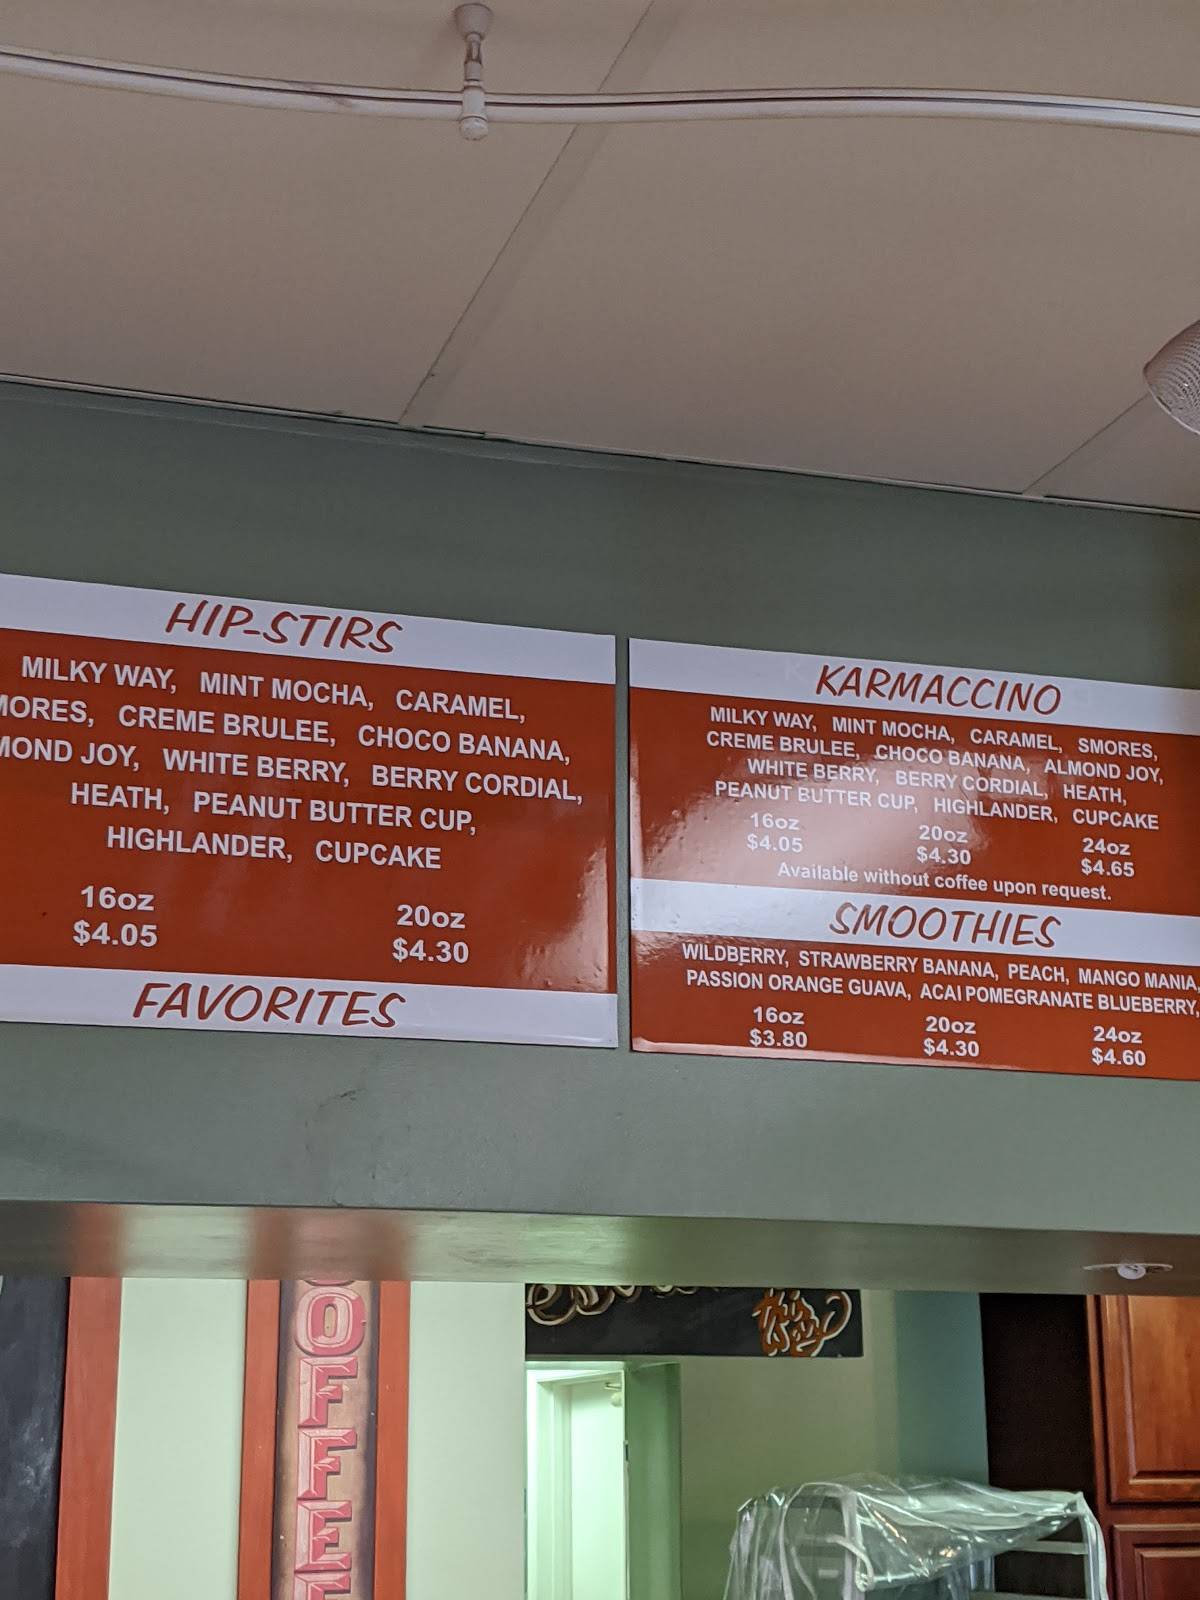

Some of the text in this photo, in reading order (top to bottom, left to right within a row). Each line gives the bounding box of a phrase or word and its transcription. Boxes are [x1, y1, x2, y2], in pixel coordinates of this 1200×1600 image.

[165, 600, 403, 653] HIP-STIRS
[22, 656, 524, 723] MILKY WAY, MINT MOCHA, CARAMEL,
[815, 664, 1061, 716] KARMACCINO
[119, 705, 214, 733] CREME
[224, 713, 335, 747] BRULEE,
[359, 725, 450, 752] CHOCO
[459, 733, 569, 765] BANANA,
[711, 707, 1157, 761] MILKY WAY, MINT MOCHA, CARAMEL, SMORES,
[81, 743, 138, 771] JOY,
[163, 749, 248, 775] WHITE
[258, 756, 348, 787] BERRY,
[373, 765, 458, 791] BERRY
[466, 773, 582, 805] CORDIAL,
[707, 731, 1163, 785] CREME BRULEE, CHOCO BANANA, ALMOND JOY,
[747, 759, 1126, 805] WHITE BERRY, BERRY CORDIAL, HEATH,
[72, 783, 475, 835] HEATH, PEANUT BUTTER CUP,
[716, 780, 1159, 829] PEANUT BUTTER CUP, HIGHLANDER, CUPCAKE
[751, 813, 800, 830] 16oz
[108, 826, 441, 868] HIGHLANDER, CUPCAKE
[747, 833, 803, 853] $4.05
[918, 824, 968, 843] 20oz
[1083, 838, 1130, 855] 24oz
[916, 844, 970, 864] $4.30
[1081, 858, 1134, 877] $4.65
[81, 886, 154, 910] 16oz
[777, 862, 1111, 901] Available without coffee upon request.
[73, 920, 157, 947] $4.05
[397, 905, 465, 928] 20oz
[830, 903, 1061, 947] SMOOTHIES
[392, 937, 468, 963] $4.30
[682, 943, 788, 968] WILDBERRY,
[799, 951, 918, 972] STRAWBERRY
[923, 958, 998, 981] BANANA,
[1008, 964, 1069, 985] PEACH,
[1079, 968, 1140, 987] MANGO
[133, 983, 406, 1027] FAVORITES
[687, 970, 1199, 1017] PASSION ORANGE GUAVA, ACAI POMEGRANATE BLUEBERRY,
[754, 1006, 804, 1024] 16oz
[926, 1016, 976, 1034] 20oz
[1094, 1026, 1142, 1043] 24oz
[750, 1028, 807, 1048] $3.80
[924, 1038, 979, 1056] $4.30
[1092, 1047, 1145, 1066] $4.60
[293, 1280, 366, 1600] OFFE
